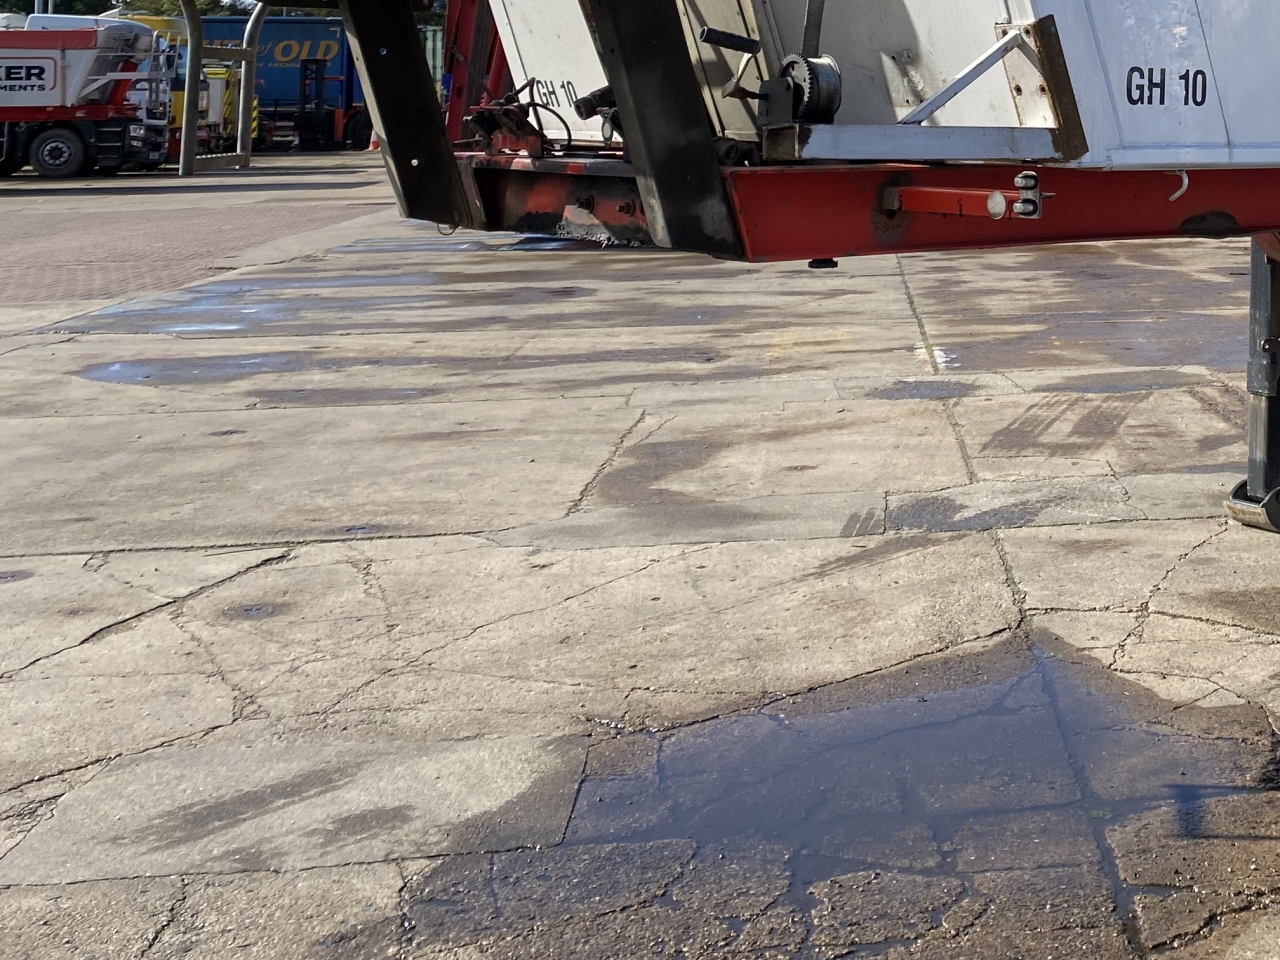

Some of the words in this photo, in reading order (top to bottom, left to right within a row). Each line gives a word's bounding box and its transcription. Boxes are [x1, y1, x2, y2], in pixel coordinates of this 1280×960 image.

[273, 40, 339, 62] OLD
[0, 65, 46, 82] ER
[535, 80, 560, 107] GH
[560, 80, 578, 108] 10
[1126, 66, 1166, 106] GH
[1179, 69, 1207, 107] 10
